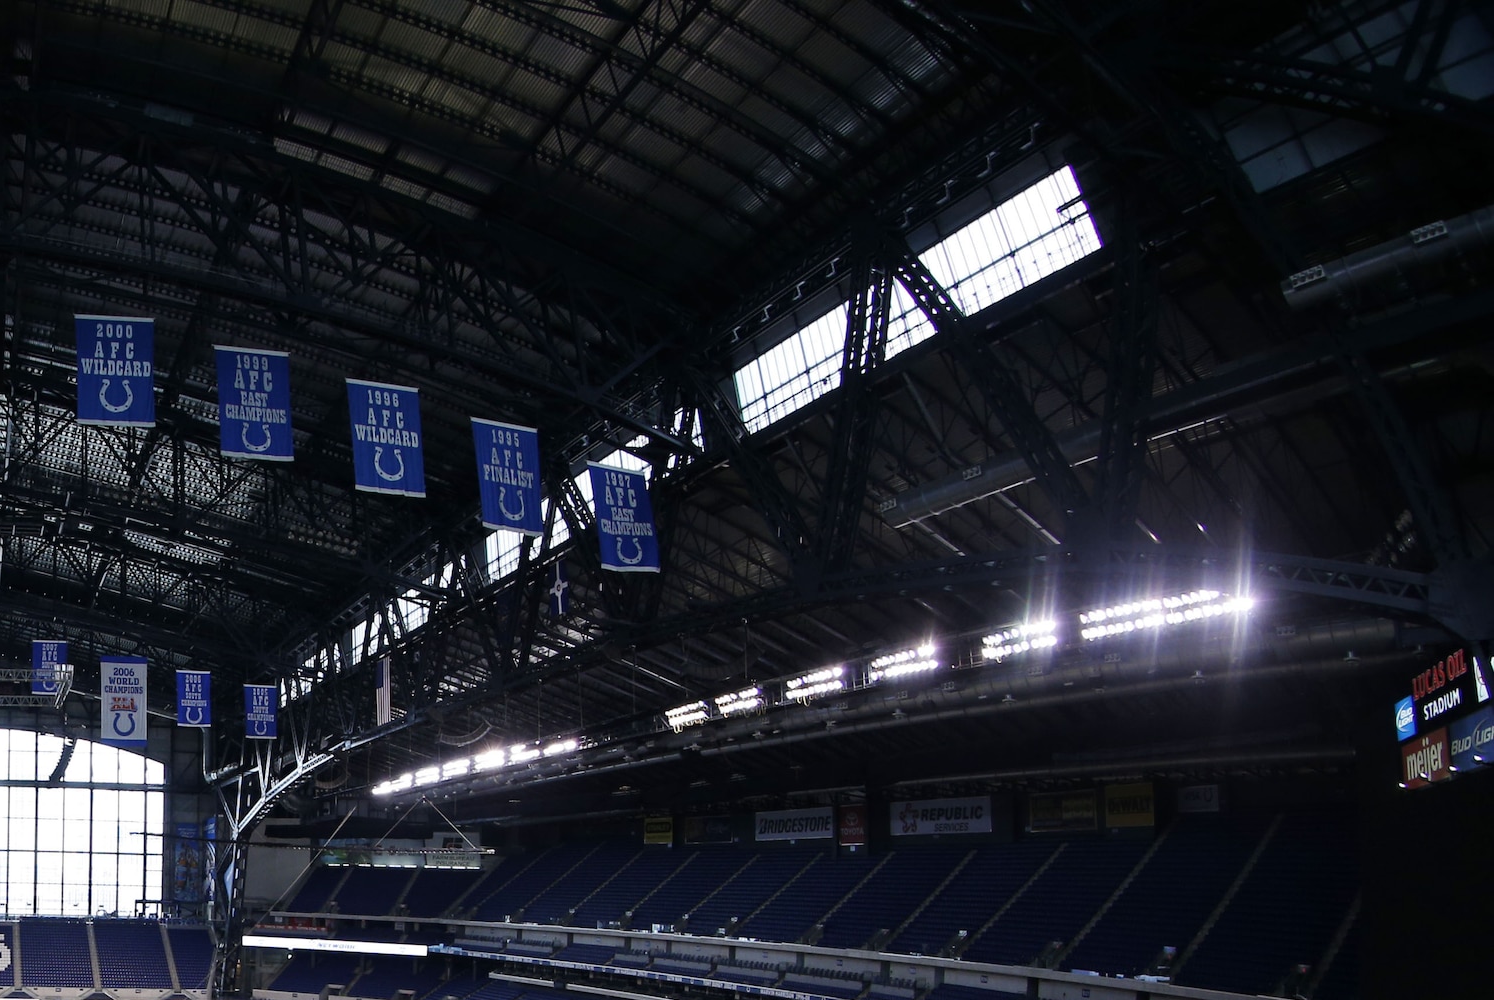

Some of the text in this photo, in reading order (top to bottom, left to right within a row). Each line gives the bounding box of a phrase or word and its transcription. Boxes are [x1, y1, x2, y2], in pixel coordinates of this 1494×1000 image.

[96, 323, 133, 339] 2000
[94, 341, 134, 359] AFC
[81, 358, 152, 377] WILDCARD
[236, 355, 269, 371] 1999
[234, 369, 273, 392] AFC
[240, 391, 269, 406] EAST
[367, 390, 399, 407] 1996
[225, 403, 287, 424] CHAMPIONS
[367, 407, 404, 429] AFC
[354, 424, 419, 448] WILDCARD
[491, 429, 519, 448] 1995
[491, 447, 523, 469] AFC
[483, 464, 533, 488] FINALIST
[605, 471, 631, 488] 1987
[605, 486, 637, 508] AFC
[611, 507, 635, 522] EAST
[600, 519, 653, 537] CHAMPIONS
[108, 677, 139, 685] WORLD
[113, 668, 134, 676] 2006
[1412, 648, 1467, 701] LUCAS OIL
[104, 686, 143, 694] CHAMPIONS
[1400, 707, 1413, 719] BUD
[1423, 688, 1460, 721] STADIUM
[1399, 713, 1414, 728] LIGHT
[1451, 736, 1471, 756] BUD
[1407, 737, 1442, 782] meijer
[921, 806, 983, 821] REPUBLIC
[758, 816, 831, 834] BRIDGESTONE
[841, 827, 864, 835] TOYOTA
[934, 822, 969, 831] SERVICES
